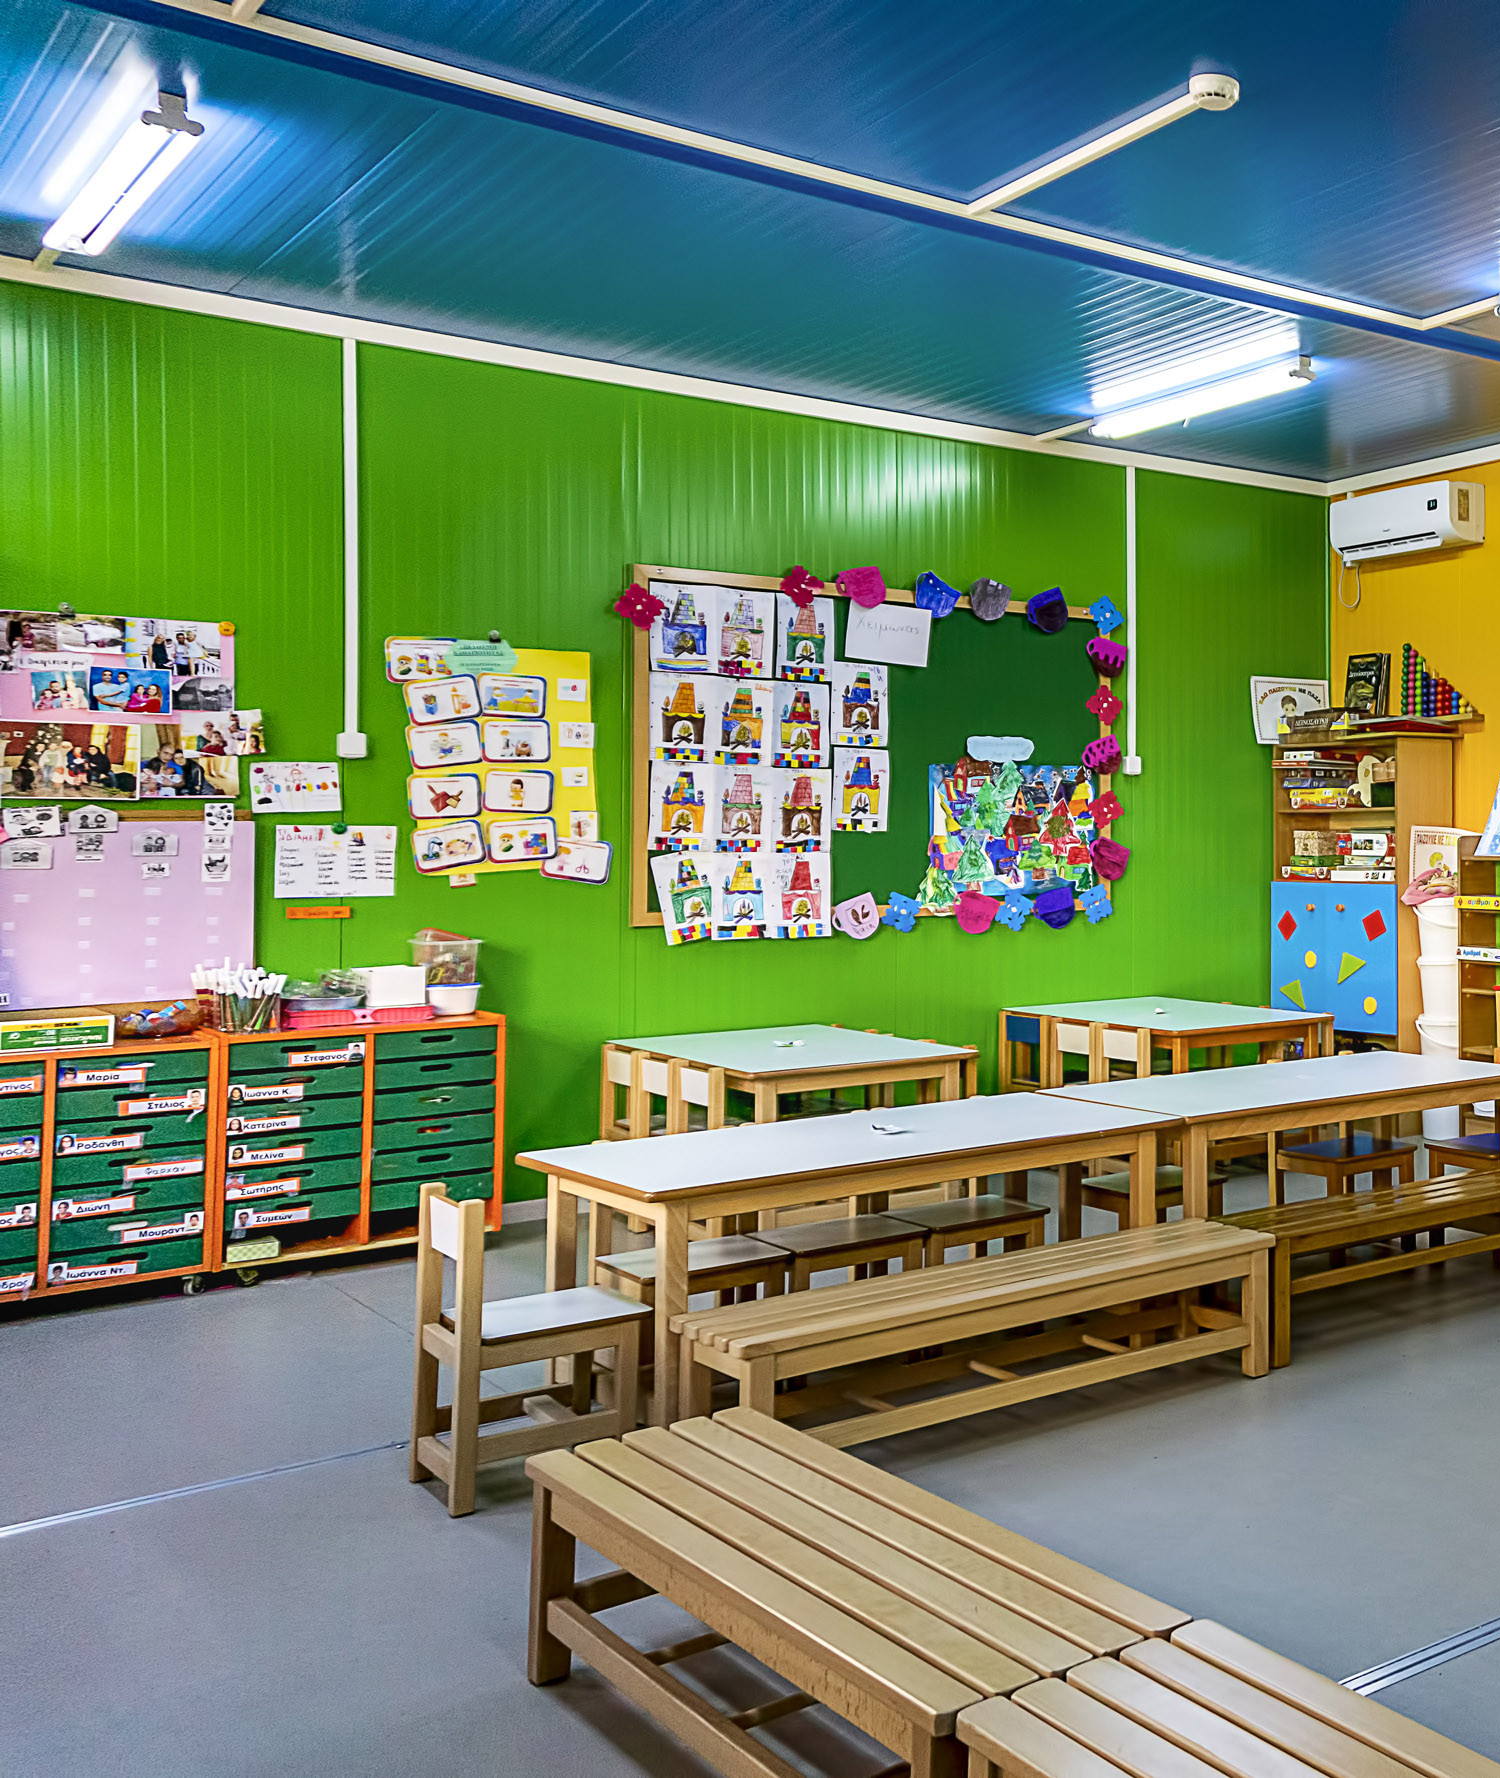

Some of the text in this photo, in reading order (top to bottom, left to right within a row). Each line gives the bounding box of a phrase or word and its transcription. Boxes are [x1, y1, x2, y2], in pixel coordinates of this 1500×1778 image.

[1268, 686, 1297, 695] ΠΑΙΖΟΥΜΕ
[86, 1074, 120, 1082] Μαρία
[243, 1120, 287, 1130] Κατερίνα
[76, 1140, 125, 1150] Ροδάνθη
[250, 1152, 284, 1160] Μελίνα
[240, 1184, 285, 1196] Σωτήρης
[76, 1203, 111, 1213] Διώνη
[255, 1213, 293, 1223] Συμεών
[66, 1269, 107, 1279] Ιωάννα
